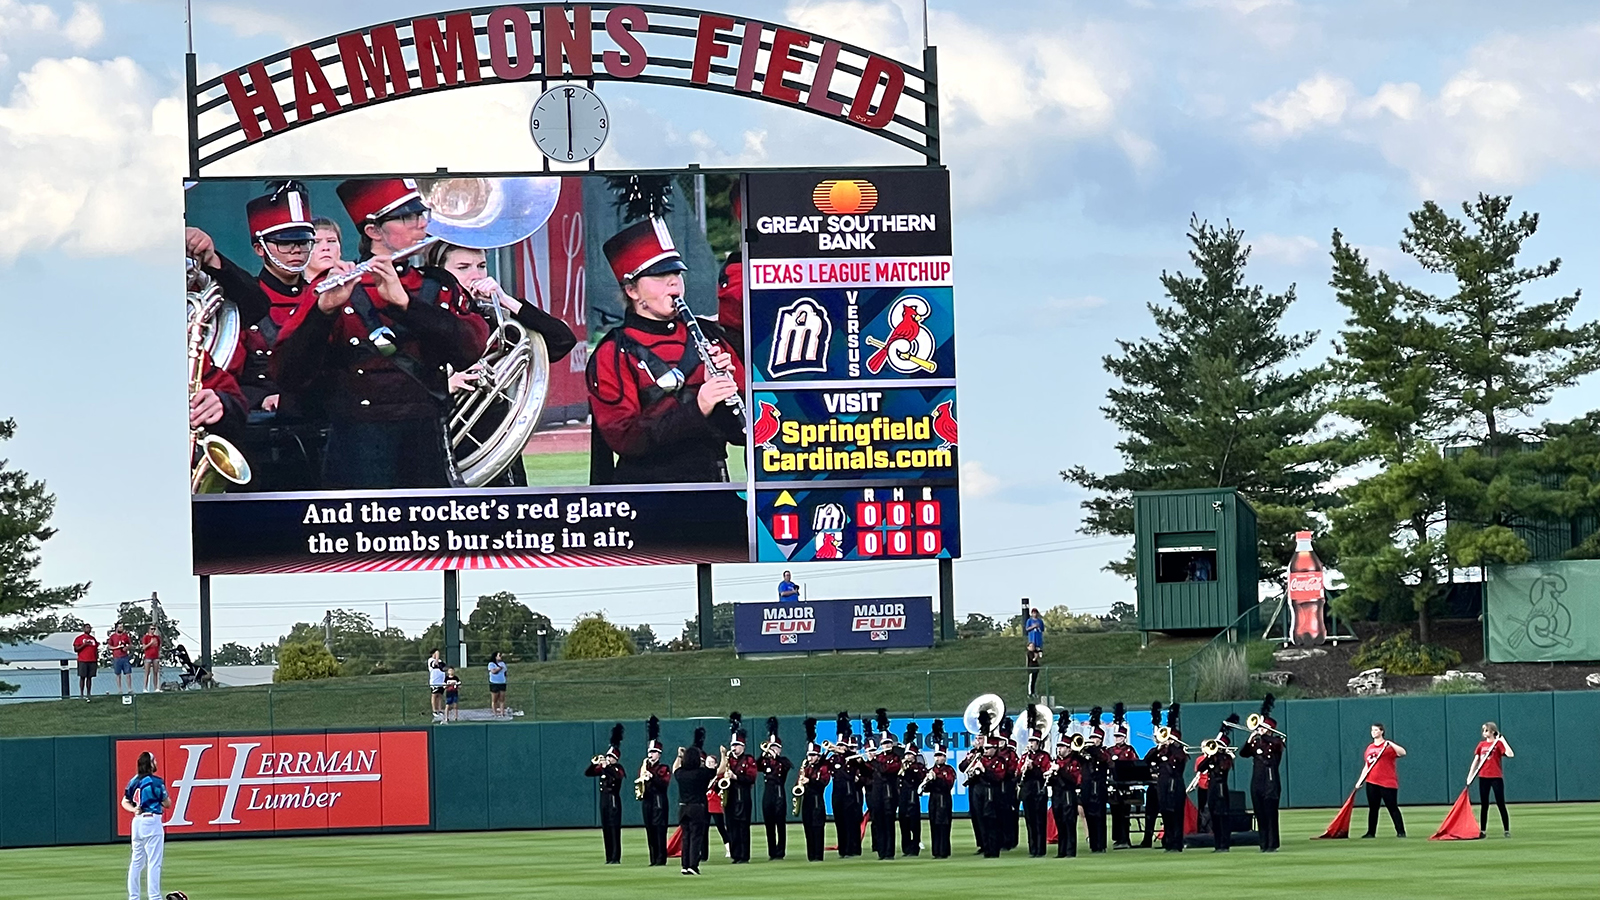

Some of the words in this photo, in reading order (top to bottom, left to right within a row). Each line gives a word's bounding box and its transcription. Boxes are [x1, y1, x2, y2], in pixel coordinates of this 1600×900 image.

[222, 6, 648, 143] HAMMONS
[690, 14, 905, 129] FIELD
[563, 88, 575, 98] 12
[533, 119, 540, 129] 9
[599, 118, 606, 129] 3
[567, 150, 574, 160] 6
[756, 215, 823, 234] GREAT
[827, 214, 936, 233] SOUTHERN
[818, 233, 875, 250] BANK
[753, 263, 803, 284] TEXAS
[808, 262, 870, 283] LEAGUE
[875, 261, 951, 282] MATCHUP
[846, 290, 860, 377] VERSUS
[823, 392, 882, 413] VISIT
[781, 416, 930, 447] Springfield
[763, 446, 952, 472] Cardinals.com
[864, 488, 875, 502] R
[893, 487, 904, 501] H
[302, 502, 353, 524] And
[360, 501, 401, 523] the
[408, 499, 510, 522] rocket's
[516, 498, 559, 520] red
[566, 497, 637, 523] glare,
[864, 505, 877, 526] 0
[893, 504, 905, 525] 0
[922, 503, 935, 524] 0
[780, 515, 792, 539] 1
[308, 532, 349, 553] the
[356, 530, 440, 553] bombs
[561, 527, 587, 548] in
[593, 527, 635, 550] air,
[864, 533, 877, 554] 0
[894, 532, 906, 553] 0
[923, 531, 935, 552] 0
[763, 606, 814, 620] MAJOR
[854, 603, 904, 617] MAJOR
[764, 620, 812, 633] FUN
[855, 617, 903, 629] FUN
[903, 731, 972, 749] IGHT
[246, 786, 341, 811] Lumber
